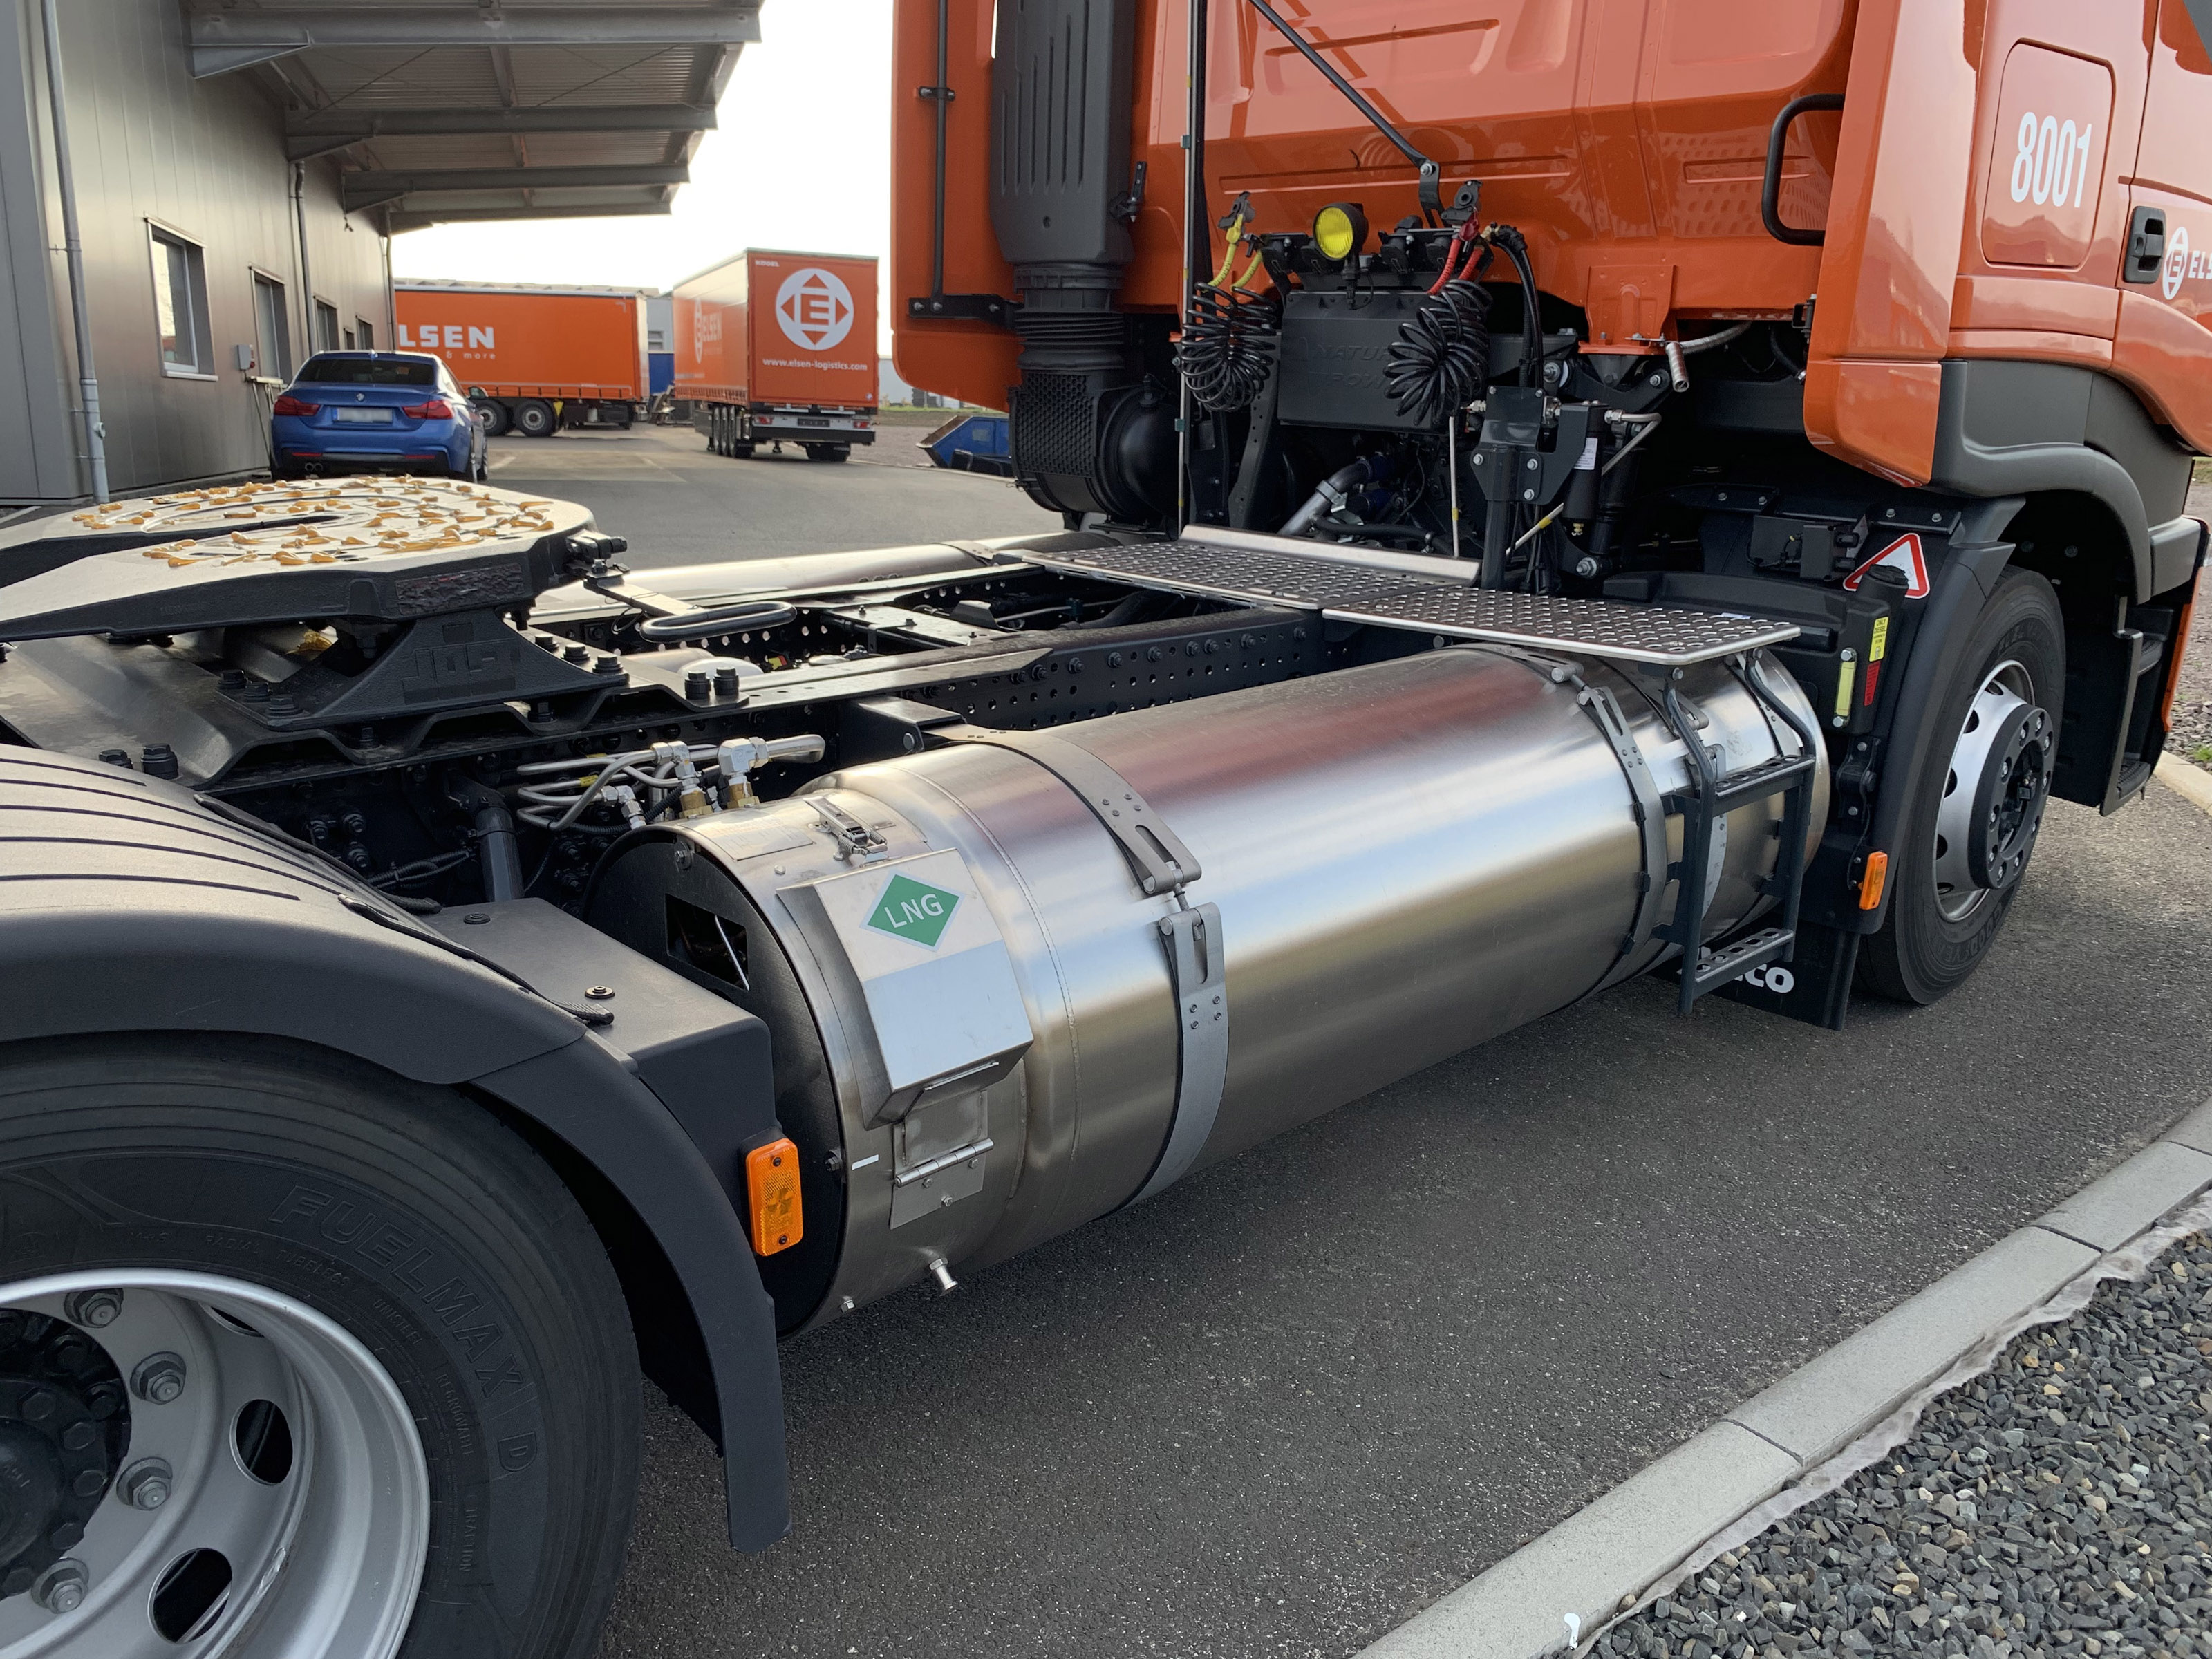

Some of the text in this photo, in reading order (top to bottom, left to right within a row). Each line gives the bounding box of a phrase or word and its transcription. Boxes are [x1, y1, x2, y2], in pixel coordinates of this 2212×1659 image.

[2011, 111, 2092, 208] 8001
[398, 324, 495, 349] LSEN
[762, 358, 868, 371] www.elsen-logistics.com
[884, 894, 944, 928] LNG
